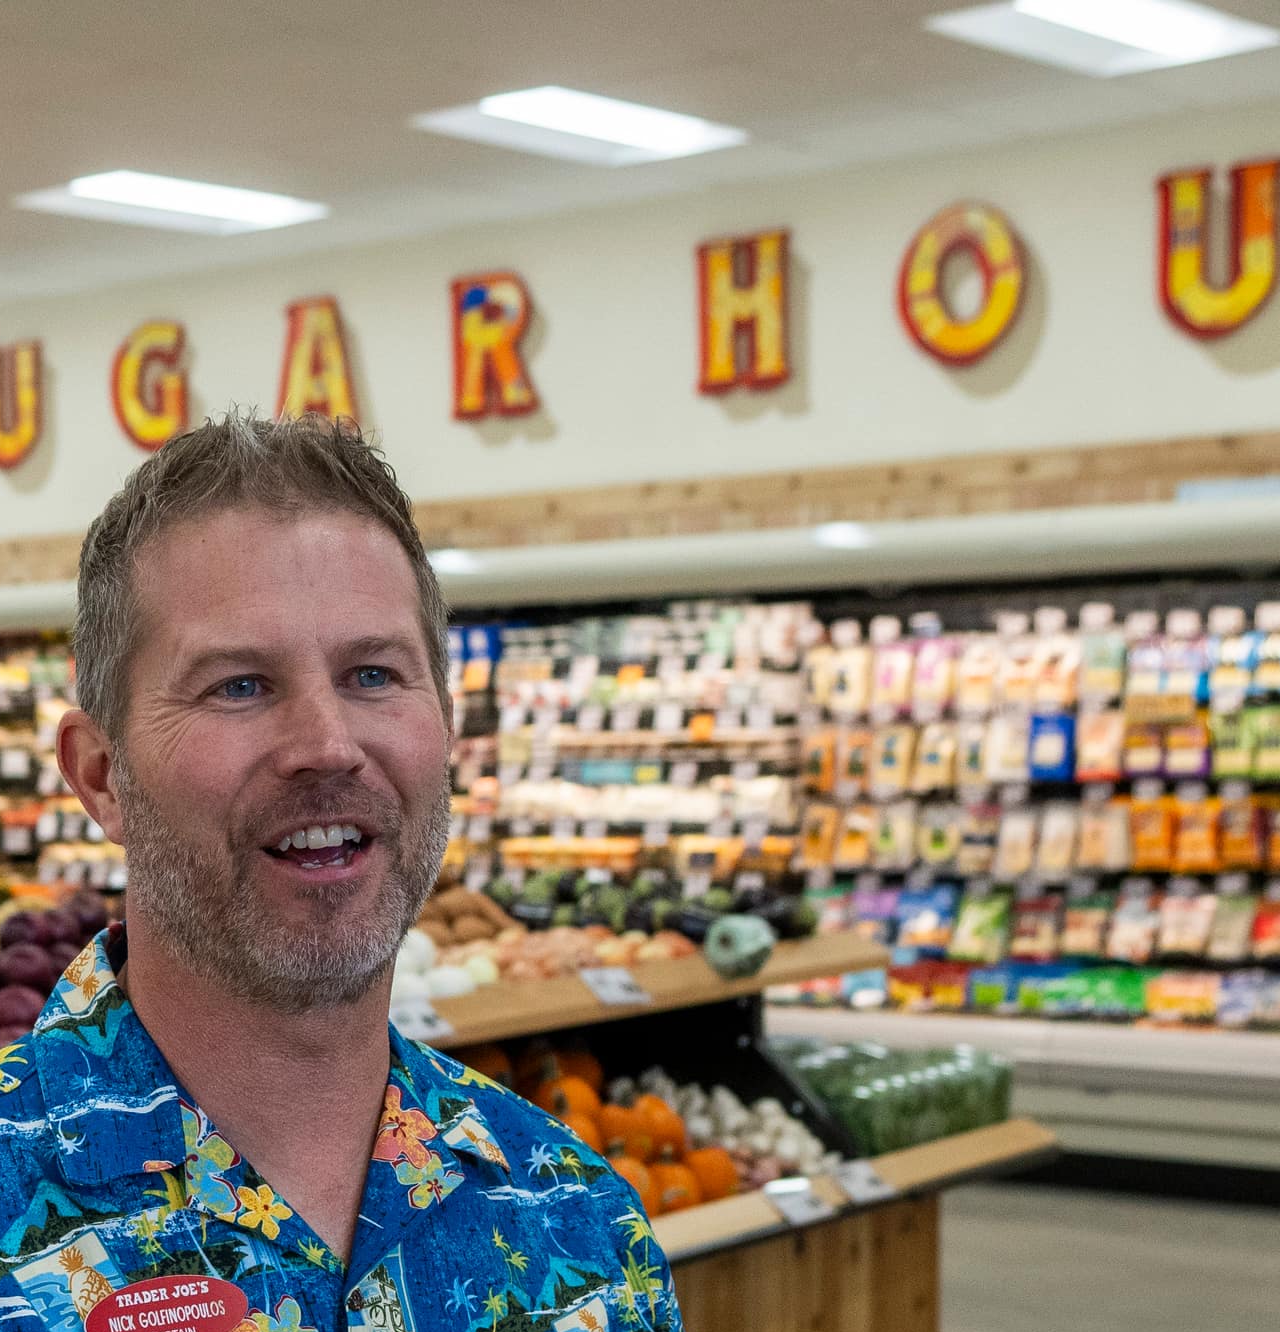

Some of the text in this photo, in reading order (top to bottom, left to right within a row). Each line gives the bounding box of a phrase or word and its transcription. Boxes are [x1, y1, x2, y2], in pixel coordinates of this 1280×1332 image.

[116, 1281, 209, 1308] TRADER JOE'S
[139, 1300, 226, 1329] GOLFINOPOULOS
